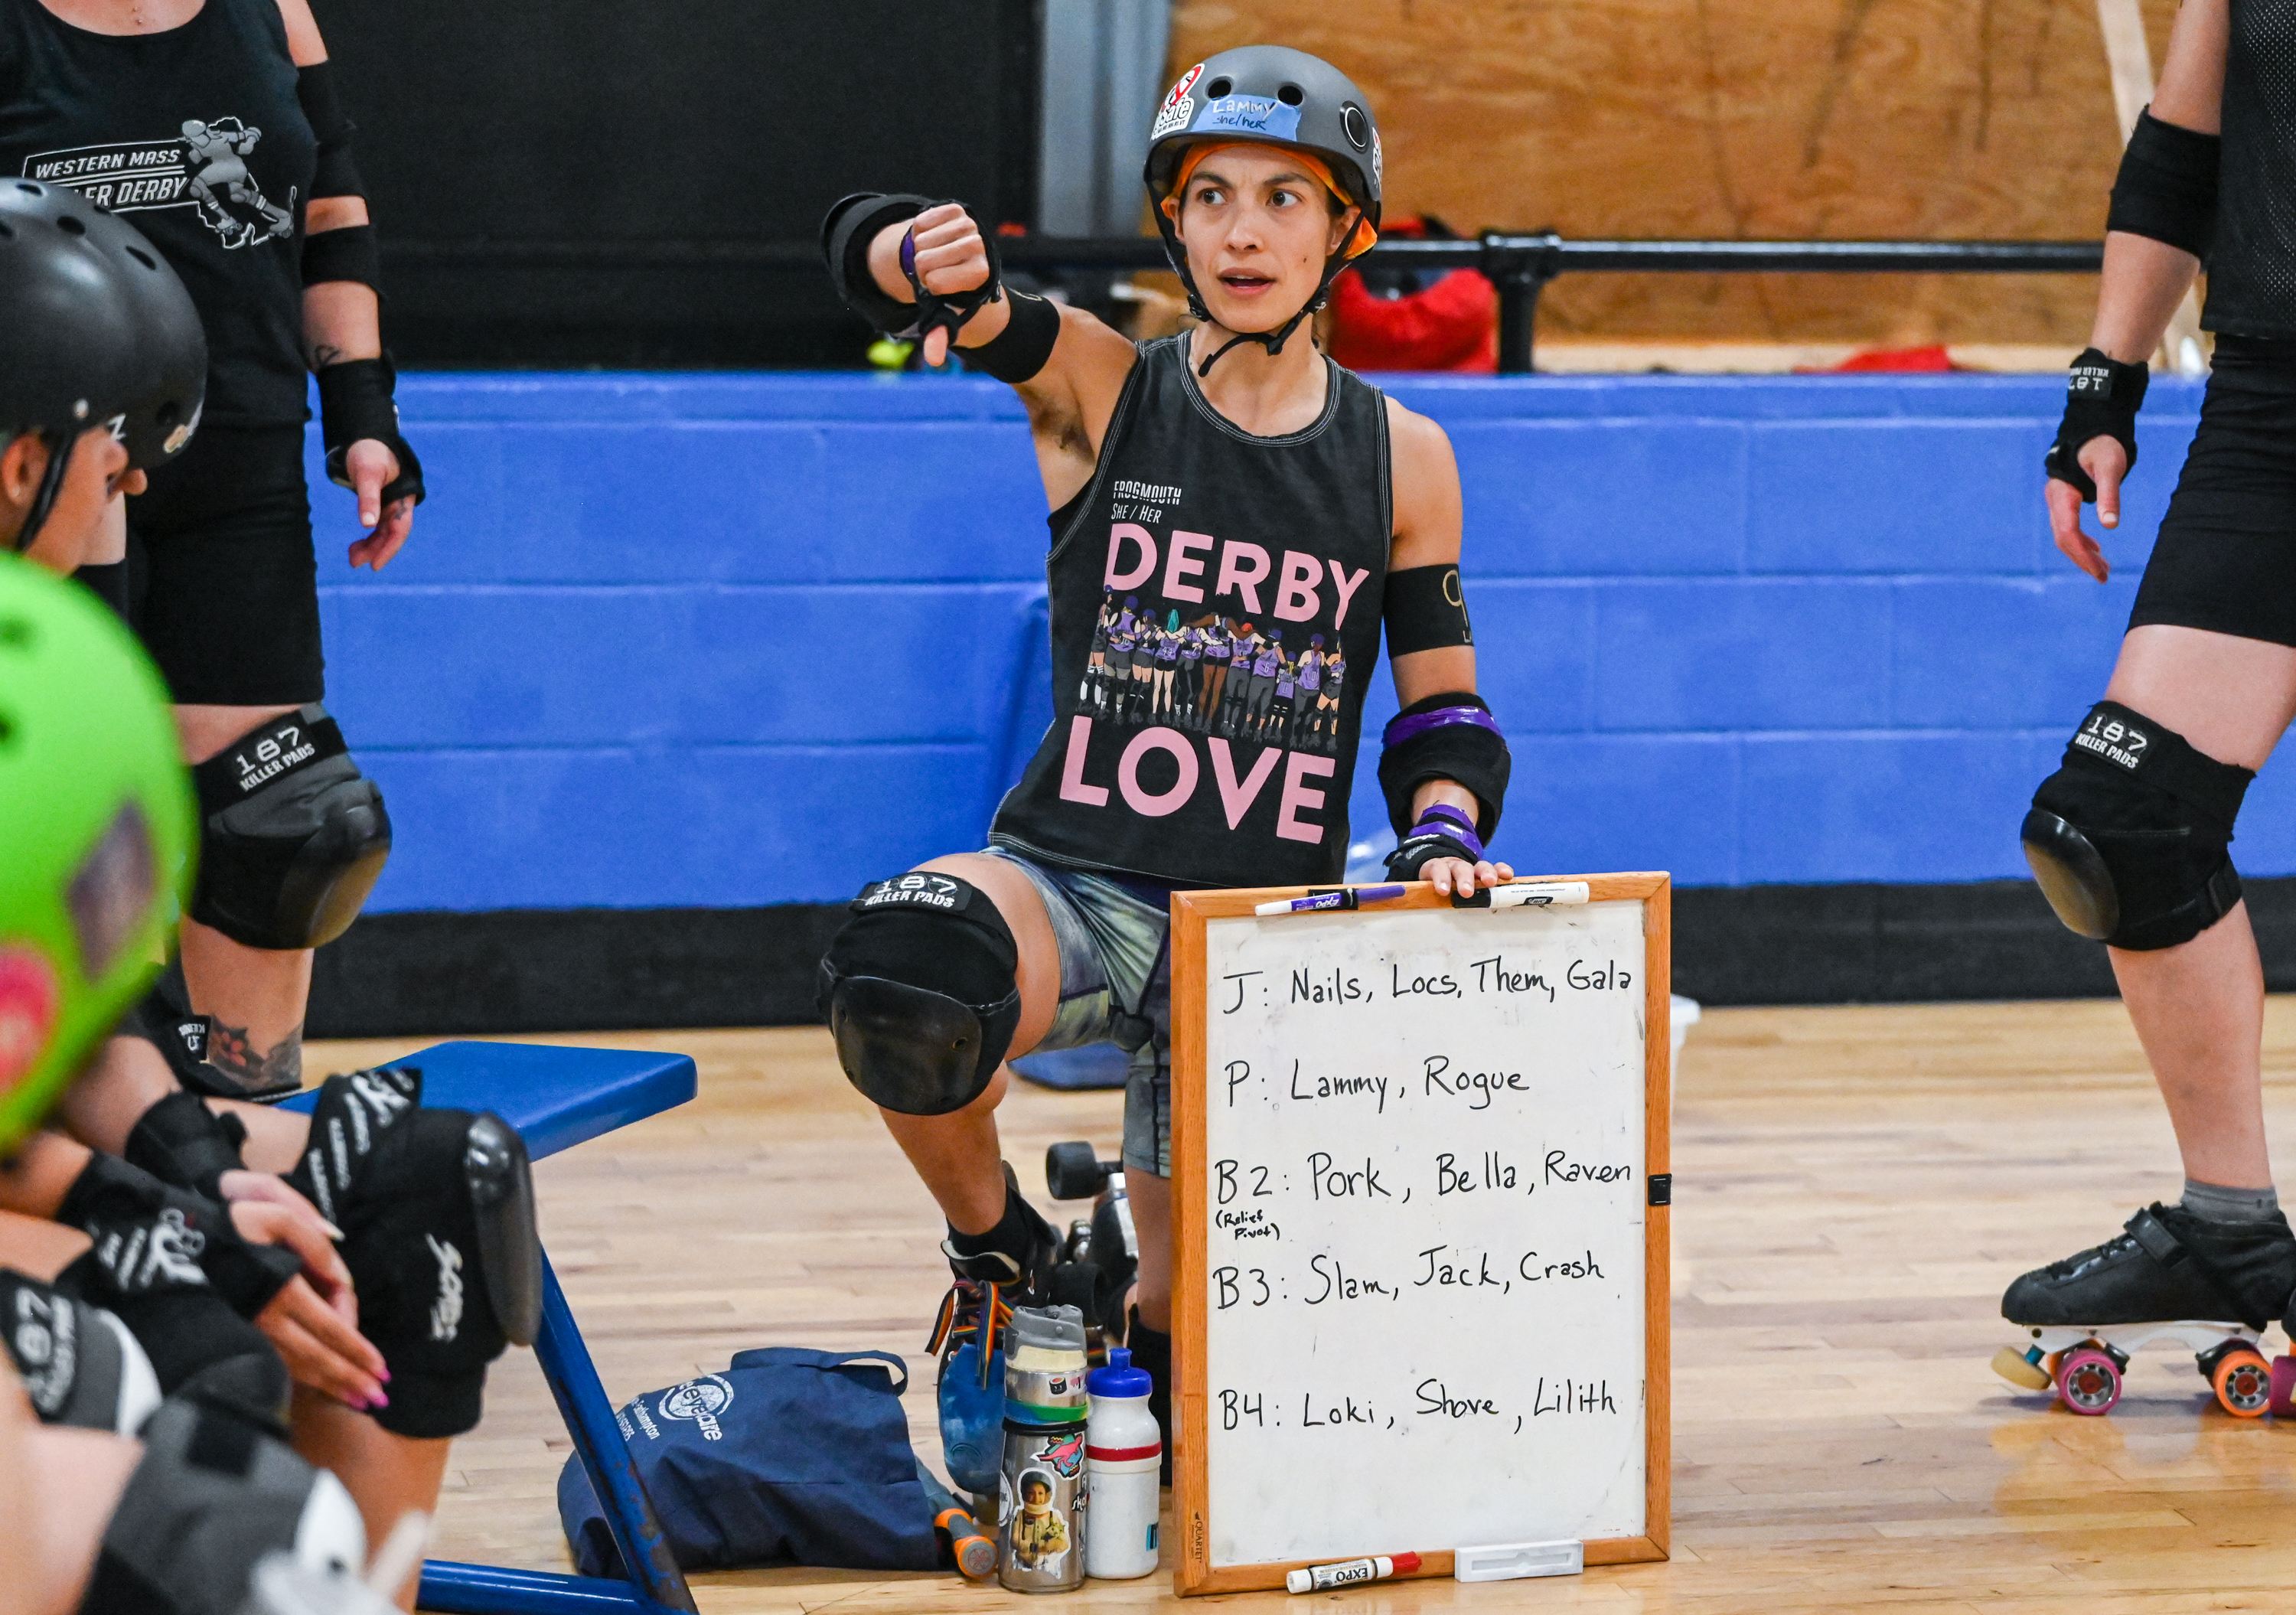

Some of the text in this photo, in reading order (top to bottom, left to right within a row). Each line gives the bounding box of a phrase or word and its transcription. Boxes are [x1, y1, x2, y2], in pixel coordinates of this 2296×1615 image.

[35, 148, 182, 179] WESTERN MASS
[116, 177, 191, 204] DERBY
[1114, 481, 1182, 505] FROGMOUTH
[1103, 524, 1370, 631] DERBY
[236, 726, 300, 776] 187
[2075, 732, 2139, 769] KILLER PADS
[2088, 716, 2148, 752] 187
[239, 742, 315, 792] KILLER PADS
[1060, 715, 1336, 844] LOVE
[865, 891, 955, 908] KILLER PADS
[877, 875, 957, 894] 187
[1224, 955, 1631, 1014] J: Nails, Locs, Them, Gala
[1225, 1060, 1267, 1107] P:
[1424, 1055, 1529, 1110] Rogue
[1544, 1150, 1631, 1183] Raven
[1305, 1254, 1399, 1304] Slam,
[1414, 1245, 1510, 1295] Jack,
[1519, 1250, 1605, 1281] Crash
[1534, 1377, 1617, 1417] Lilith
[1195, 1521, 1203, 1560] QUARTET
[1336, 1567, 1368, 1582] EXPO
